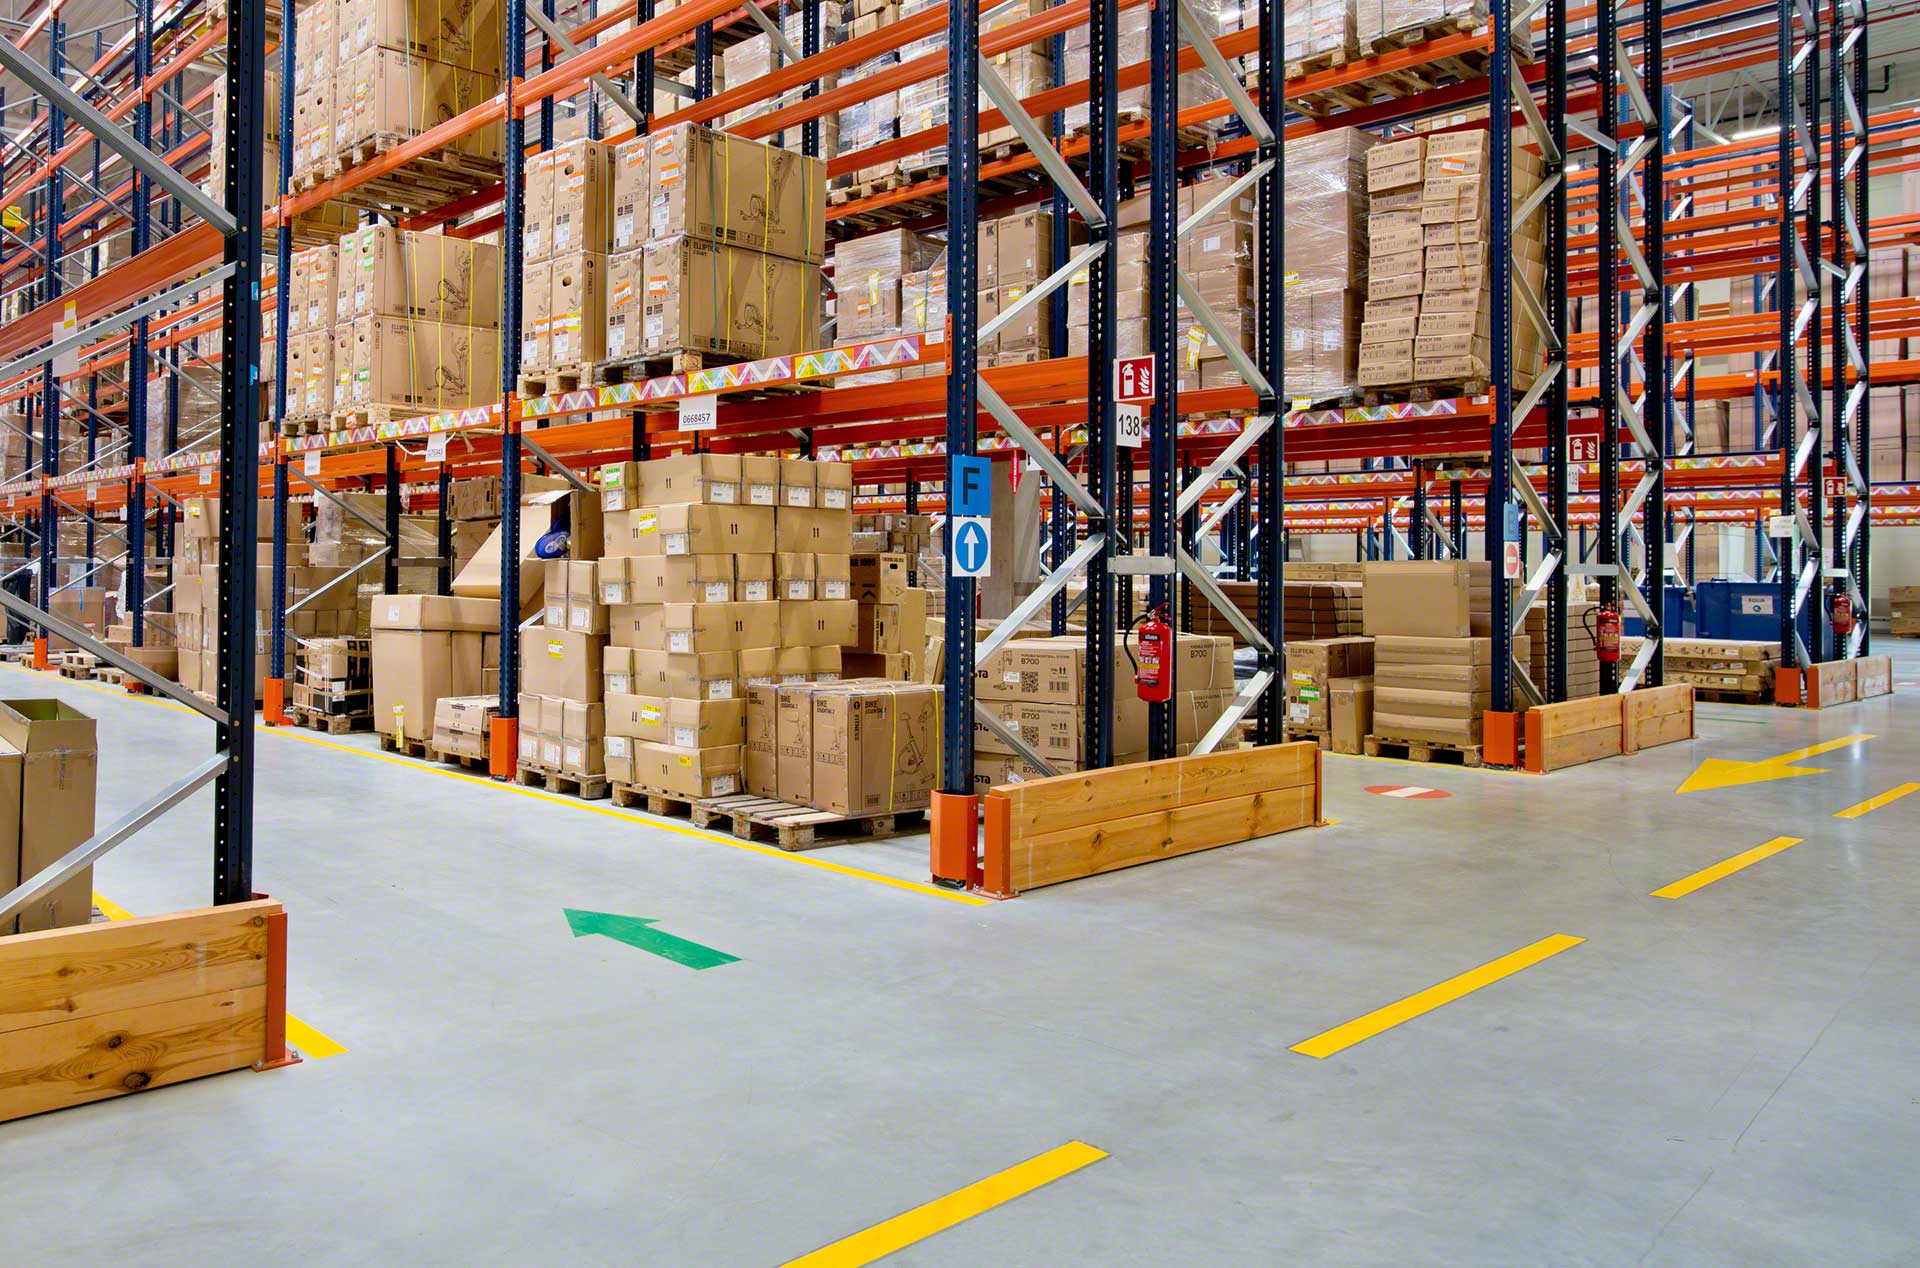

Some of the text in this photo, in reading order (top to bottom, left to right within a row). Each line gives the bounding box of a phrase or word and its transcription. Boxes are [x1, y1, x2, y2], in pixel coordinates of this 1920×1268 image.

[683, 413, 711, 424] 0668457
[1118, 414, 1140, 437] 138
[963, 467, 980, 505] F
[1507, 510, 1514, 534] E
[1190, 649, 1208, 658] B700
[781, 695, 790, 703] BIKE
[817, 699, 827, 707] BIKE
[865, 700, 878, 708] BIKE
